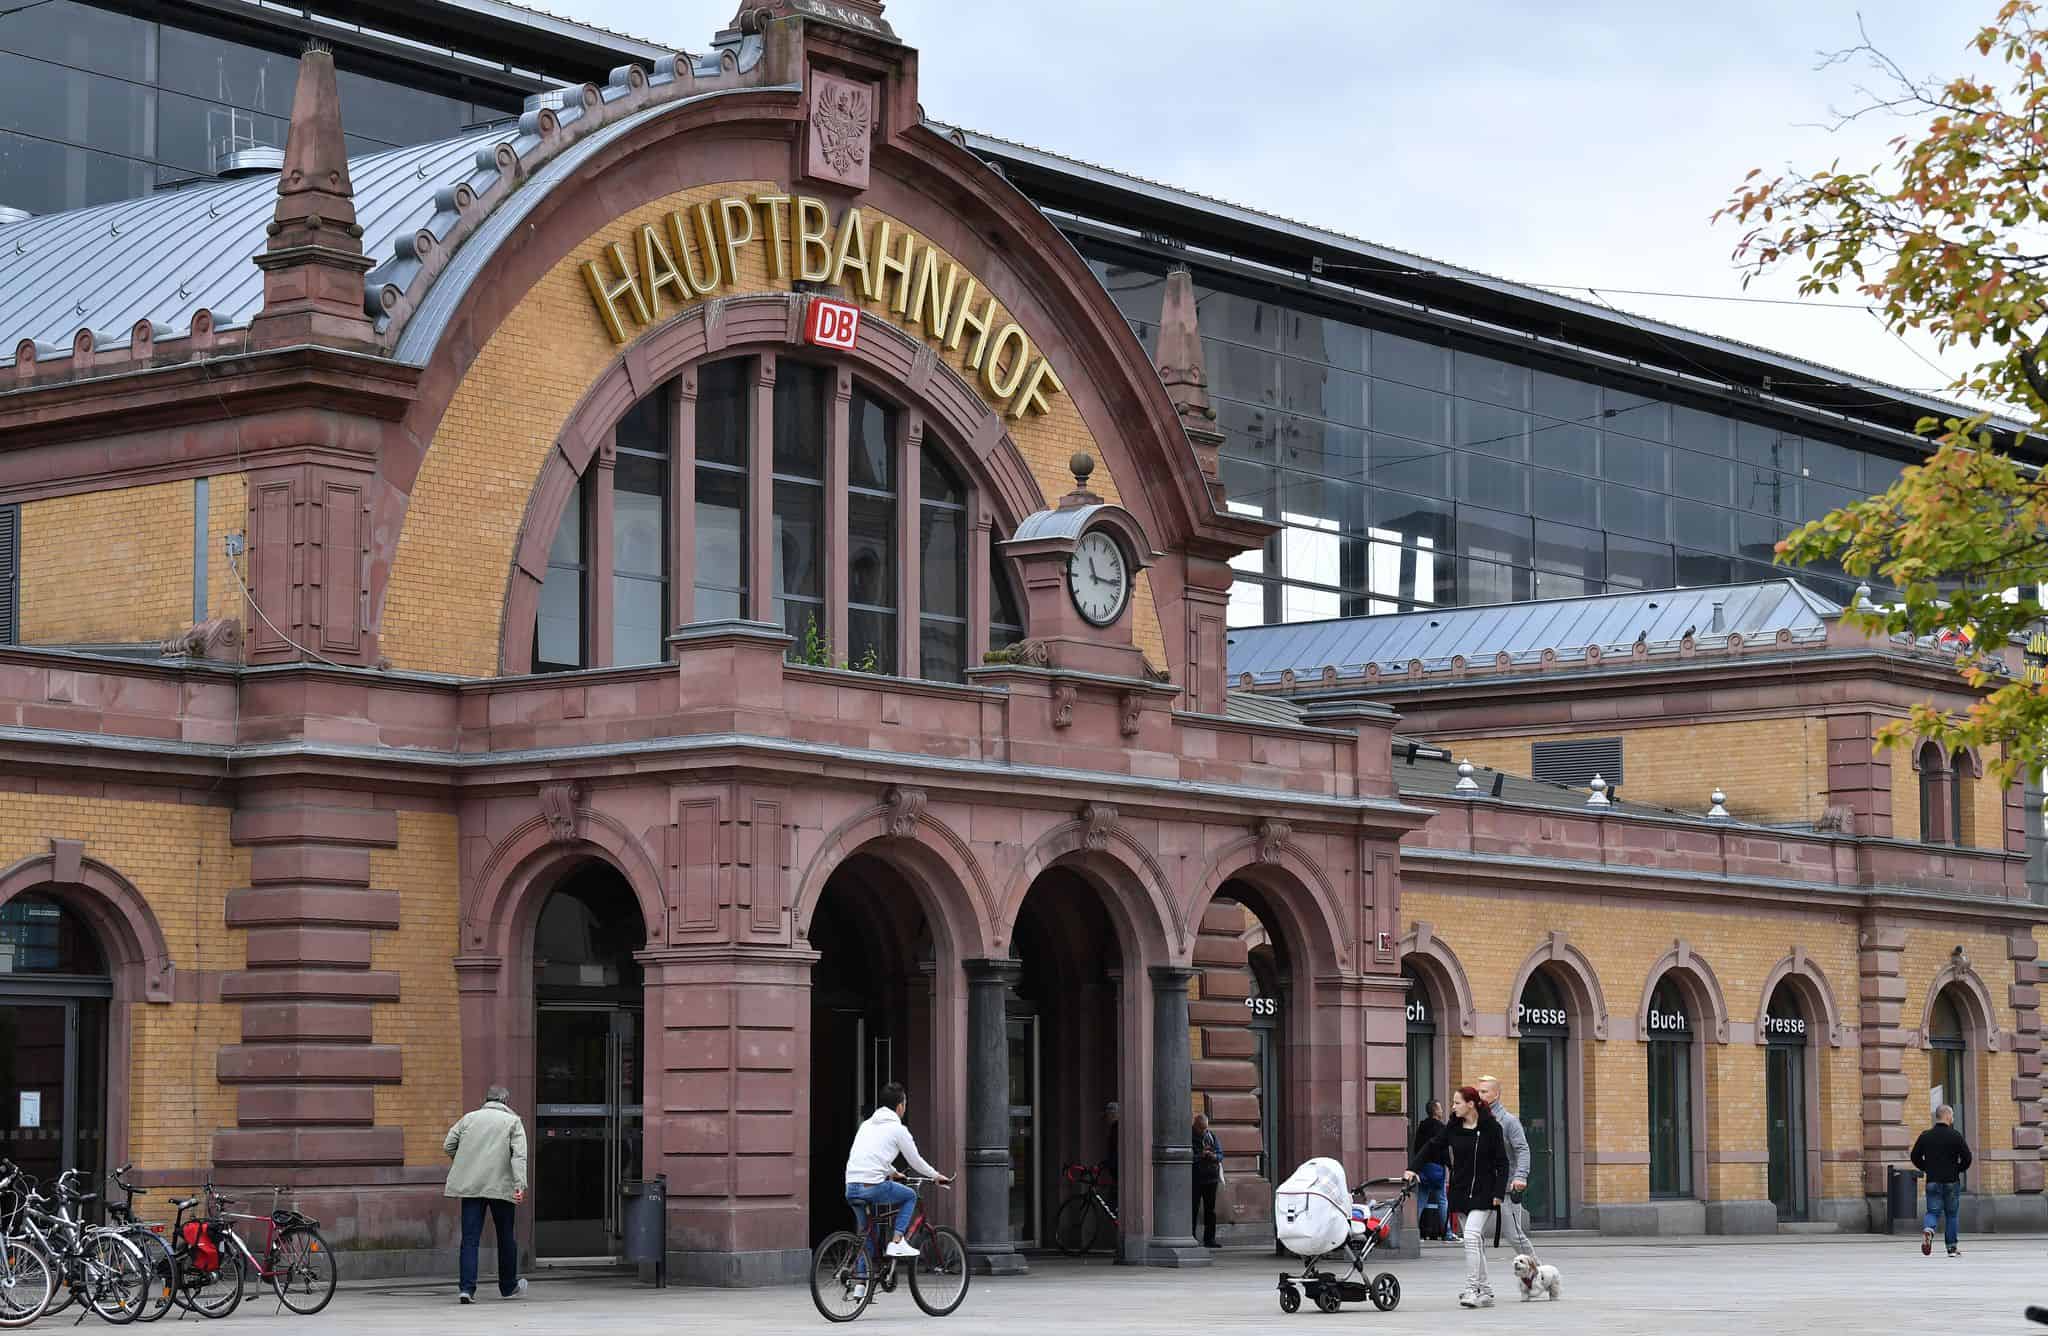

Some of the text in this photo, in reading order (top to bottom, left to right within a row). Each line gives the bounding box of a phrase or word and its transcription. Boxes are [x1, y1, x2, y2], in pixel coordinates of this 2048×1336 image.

[580, 193, 1063, 419] HAUPTBAHNHOF
[819, 307, 853, 342] DB
[1519, 1003, 1566, 1025] Presse
[1651, 1010, 1685, 1030] Buch
